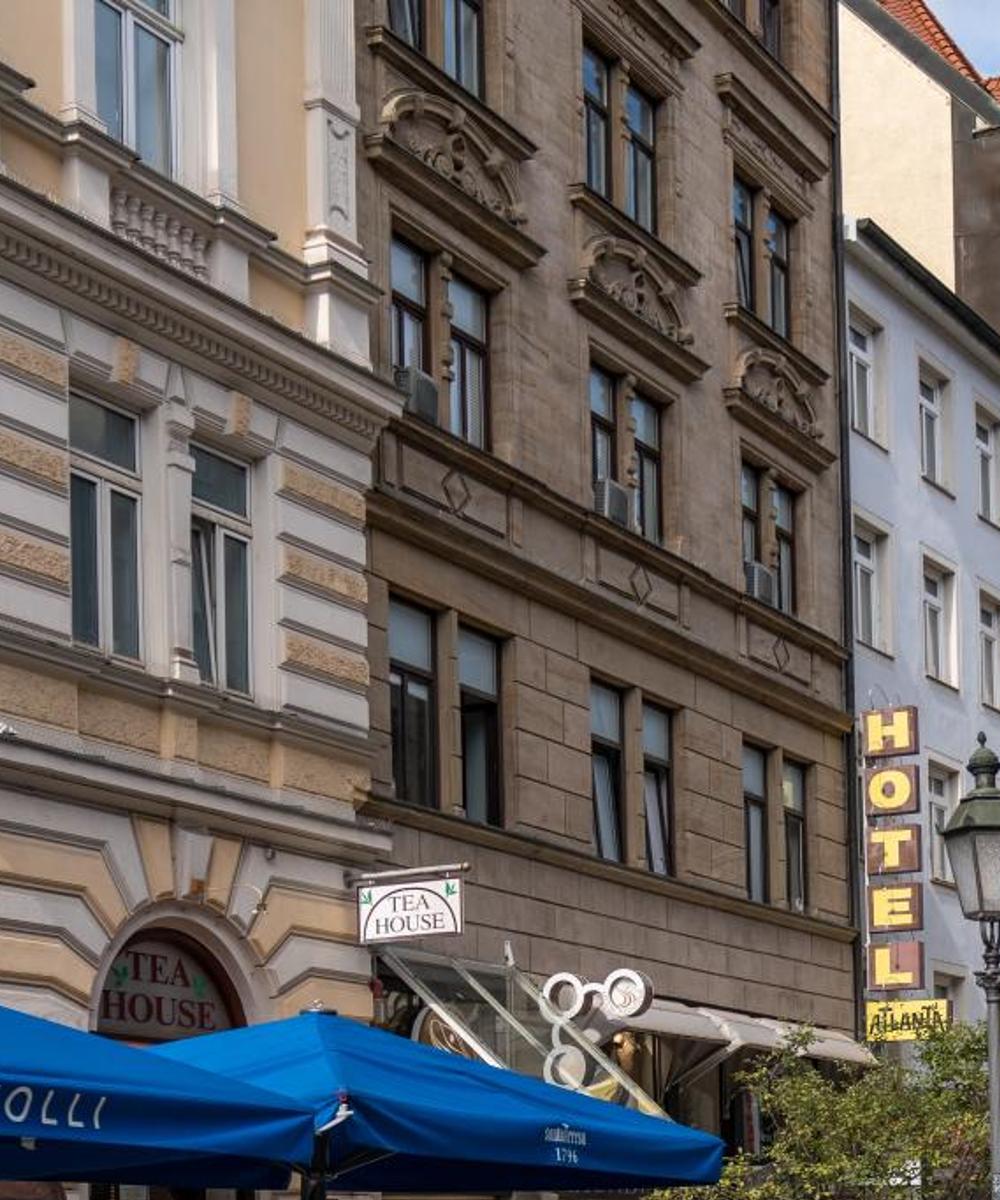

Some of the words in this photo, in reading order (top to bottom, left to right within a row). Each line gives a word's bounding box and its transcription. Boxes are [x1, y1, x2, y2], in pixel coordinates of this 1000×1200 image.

[867, 711, 914, 986] HOTEL
[388, 894, 430, 912] TEA
[375, 912, 446, 935] HOUSE
[127, 951, 190, 987] TEA
[102, 989, 216, 1031] HOUSE
[0, 1085, 107, 1130] OLLI
